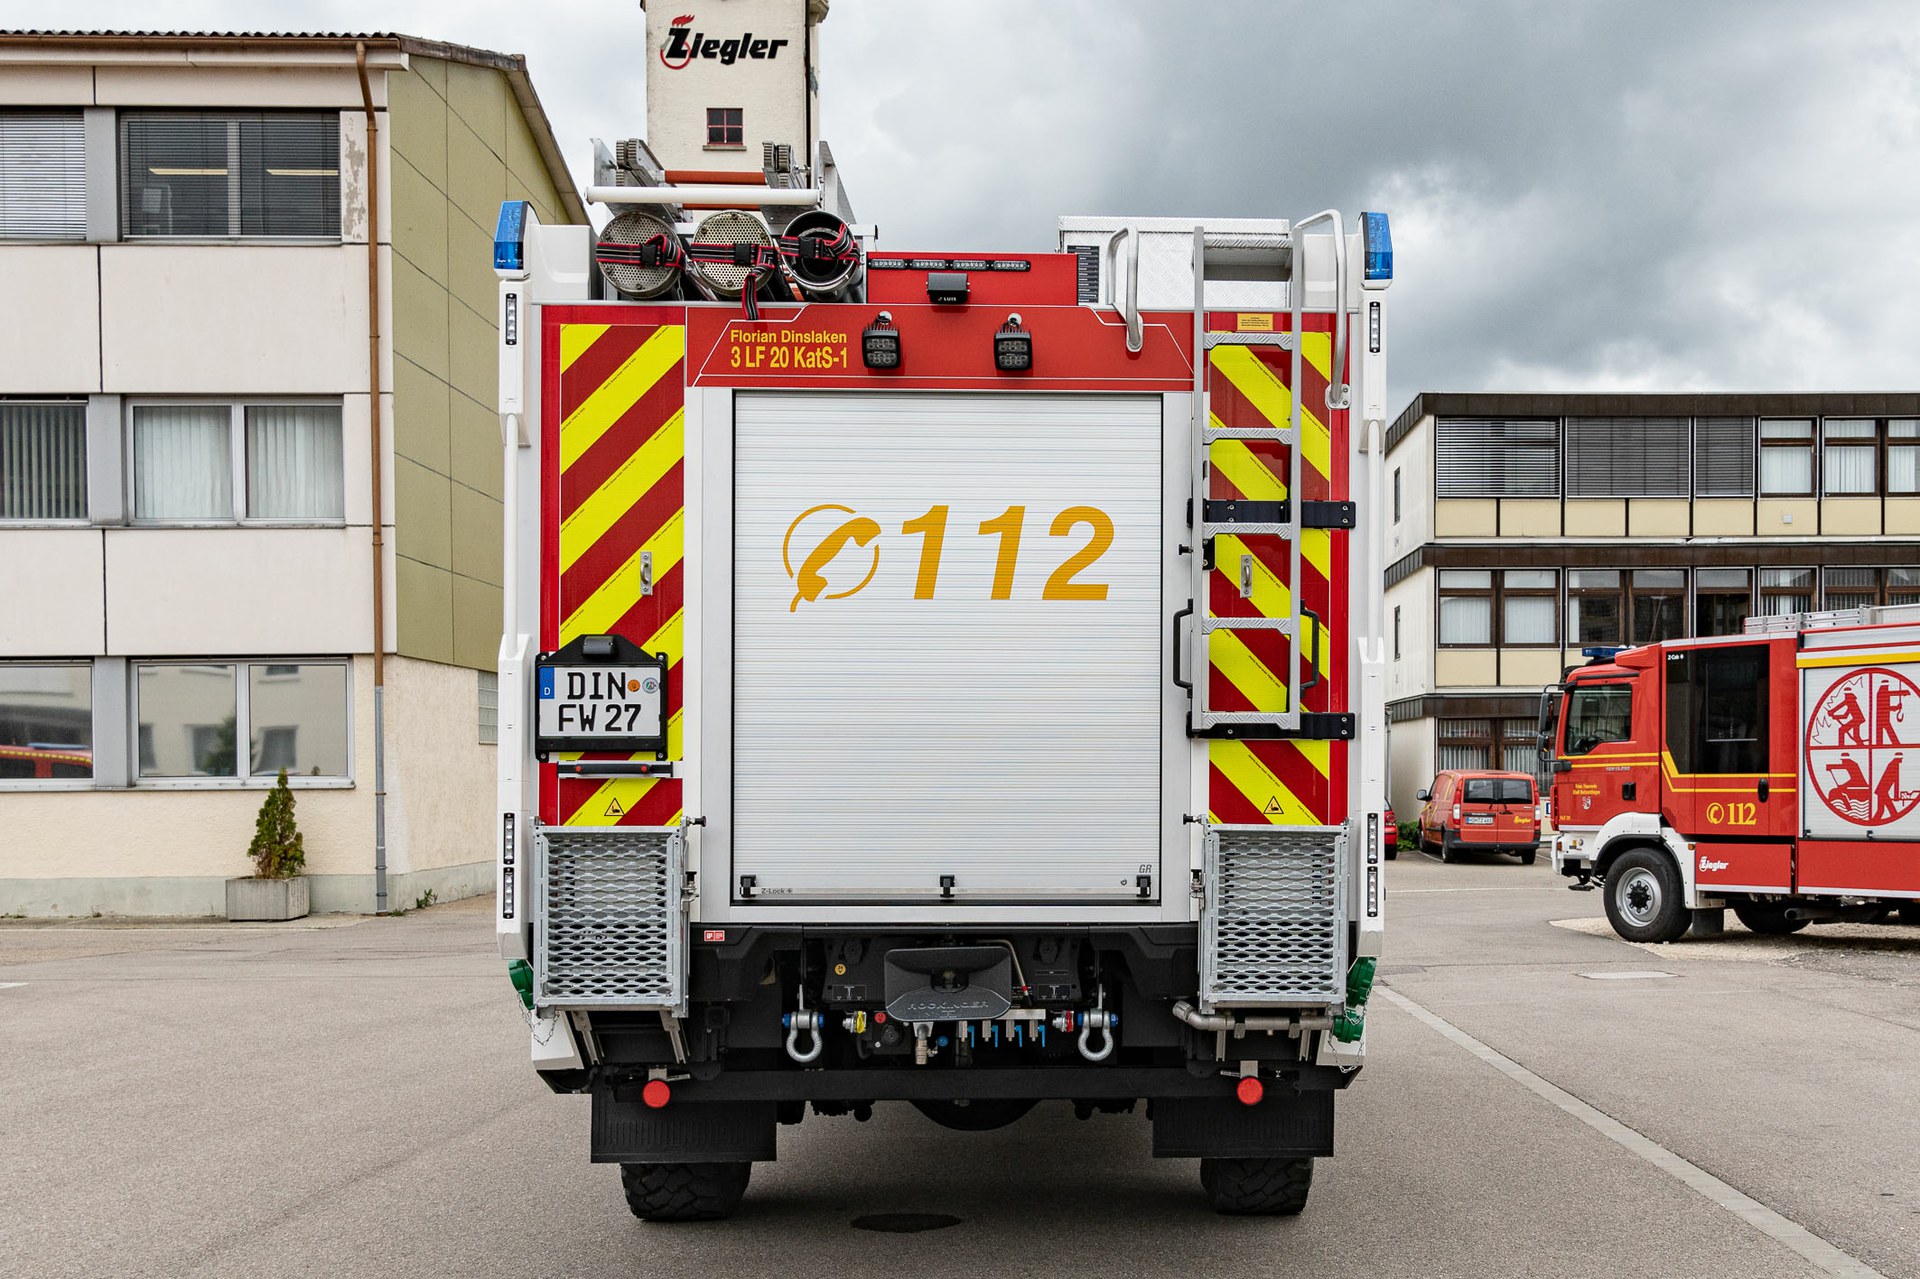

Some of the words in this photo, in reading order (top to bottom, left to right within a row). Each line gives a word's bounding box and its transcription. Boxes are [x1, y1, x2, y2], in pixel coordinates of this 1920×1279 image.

[665, 27, 789, 66] Ziegler
[730, 329, 777, 343] Florian
[781, 329, 847, 344] Dinslaken
[730, 346, 741, 368] 3
[745, 346, 766, 368] LF
[770, 346, 790, 368] 20
[794, 346, 848, 369] KatS-1
[901, 505, 1115, 601] 112
[544, 686, 551, 696] D
[567, 671, 626, 700] DIN
[558, 703, 597, 732] FW
[605, 703, 642, 732] 27
[1727, 802, 1757, 826] 112
[1139, 864, 1152, 873] GR
[1699, 856, 1729, 872] Ziegler
[761, 887, 785, 895] Z-Lock
